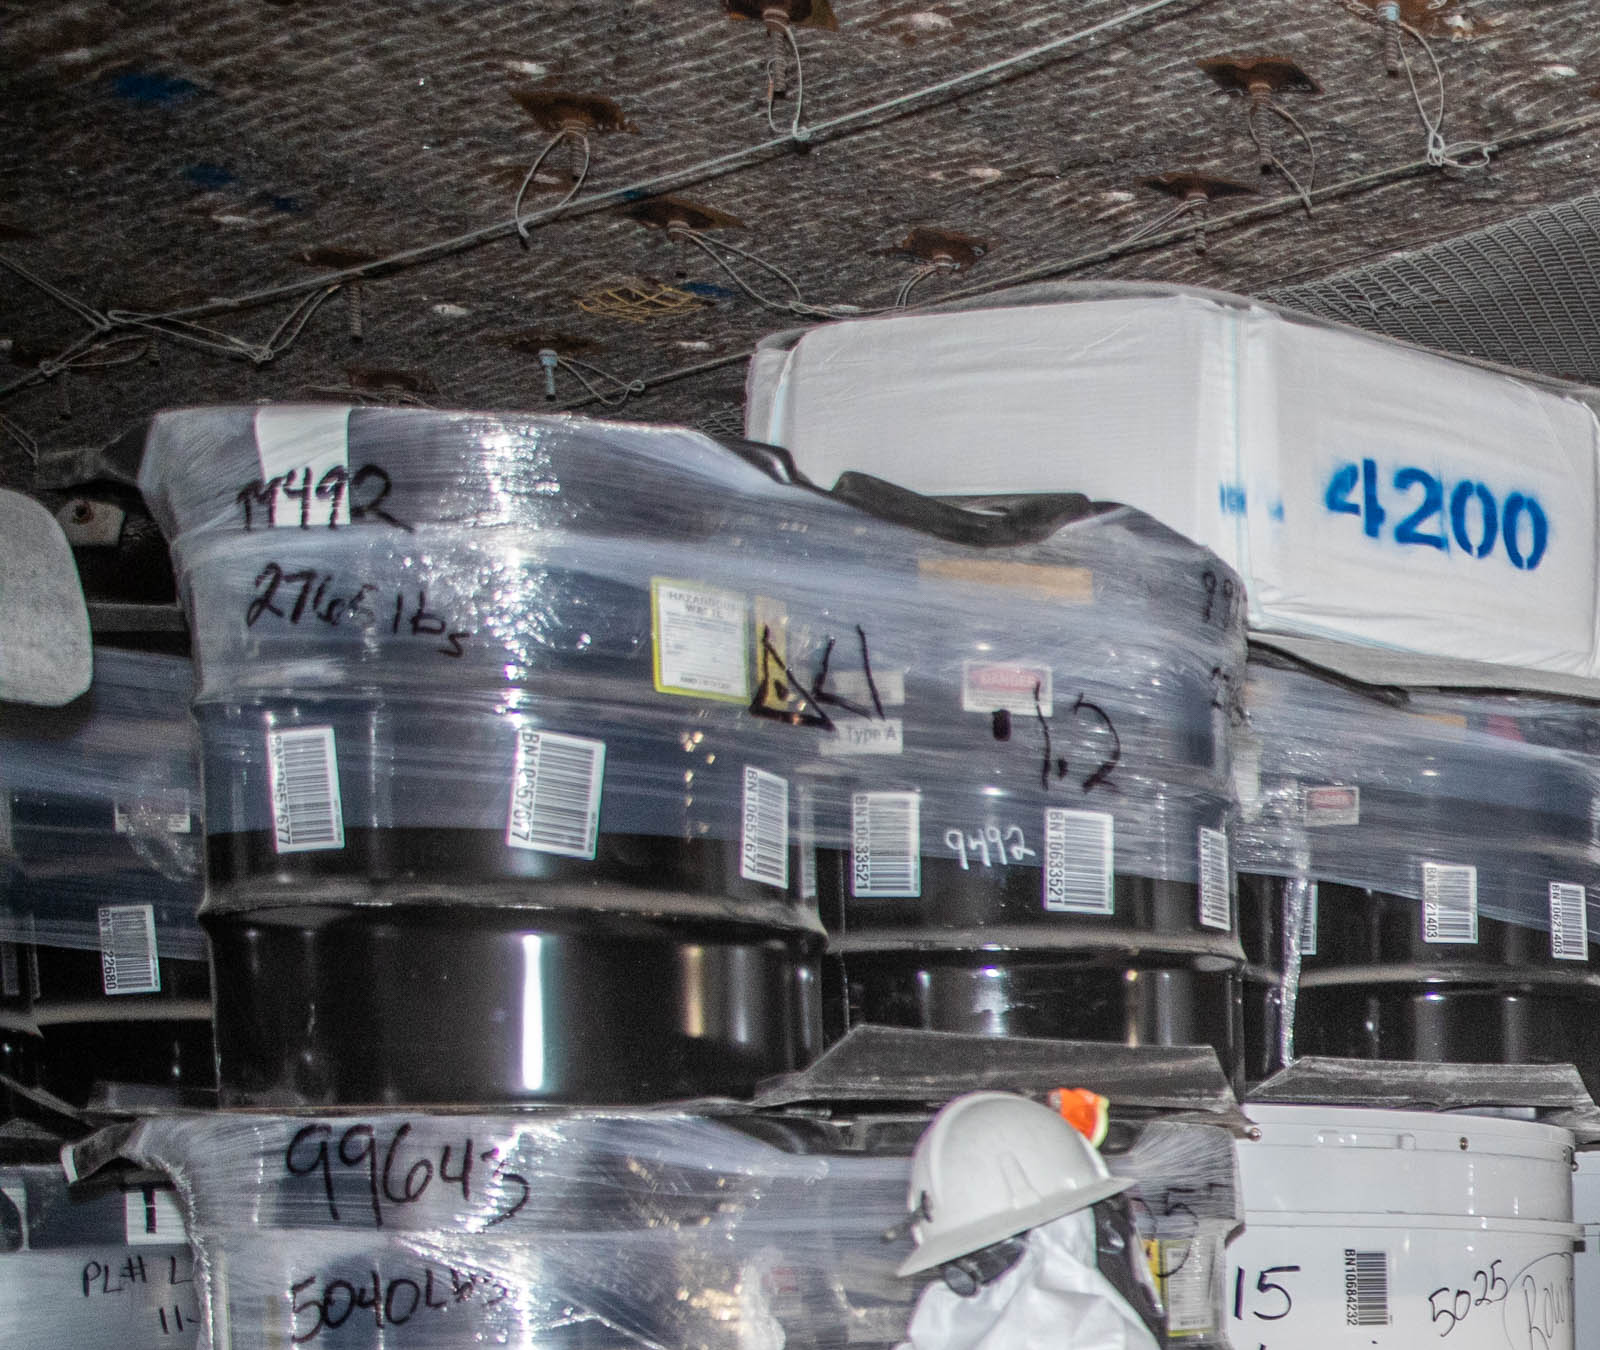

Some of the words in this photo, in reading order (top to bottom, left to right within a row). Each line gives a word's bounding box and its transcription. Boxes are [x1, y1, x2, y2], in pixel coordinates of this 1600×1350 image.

[1325, 458, 1548, 571] 4200
[741, 769, 760, 876] BN10657677
[853, 794, 869, 895] BN10633521
[1047, 811, 1065, 906] BN10633521
[1550, 884, 1564, 956] BN10621403
[1343, 1248, 1359, 1327] BN10684232
